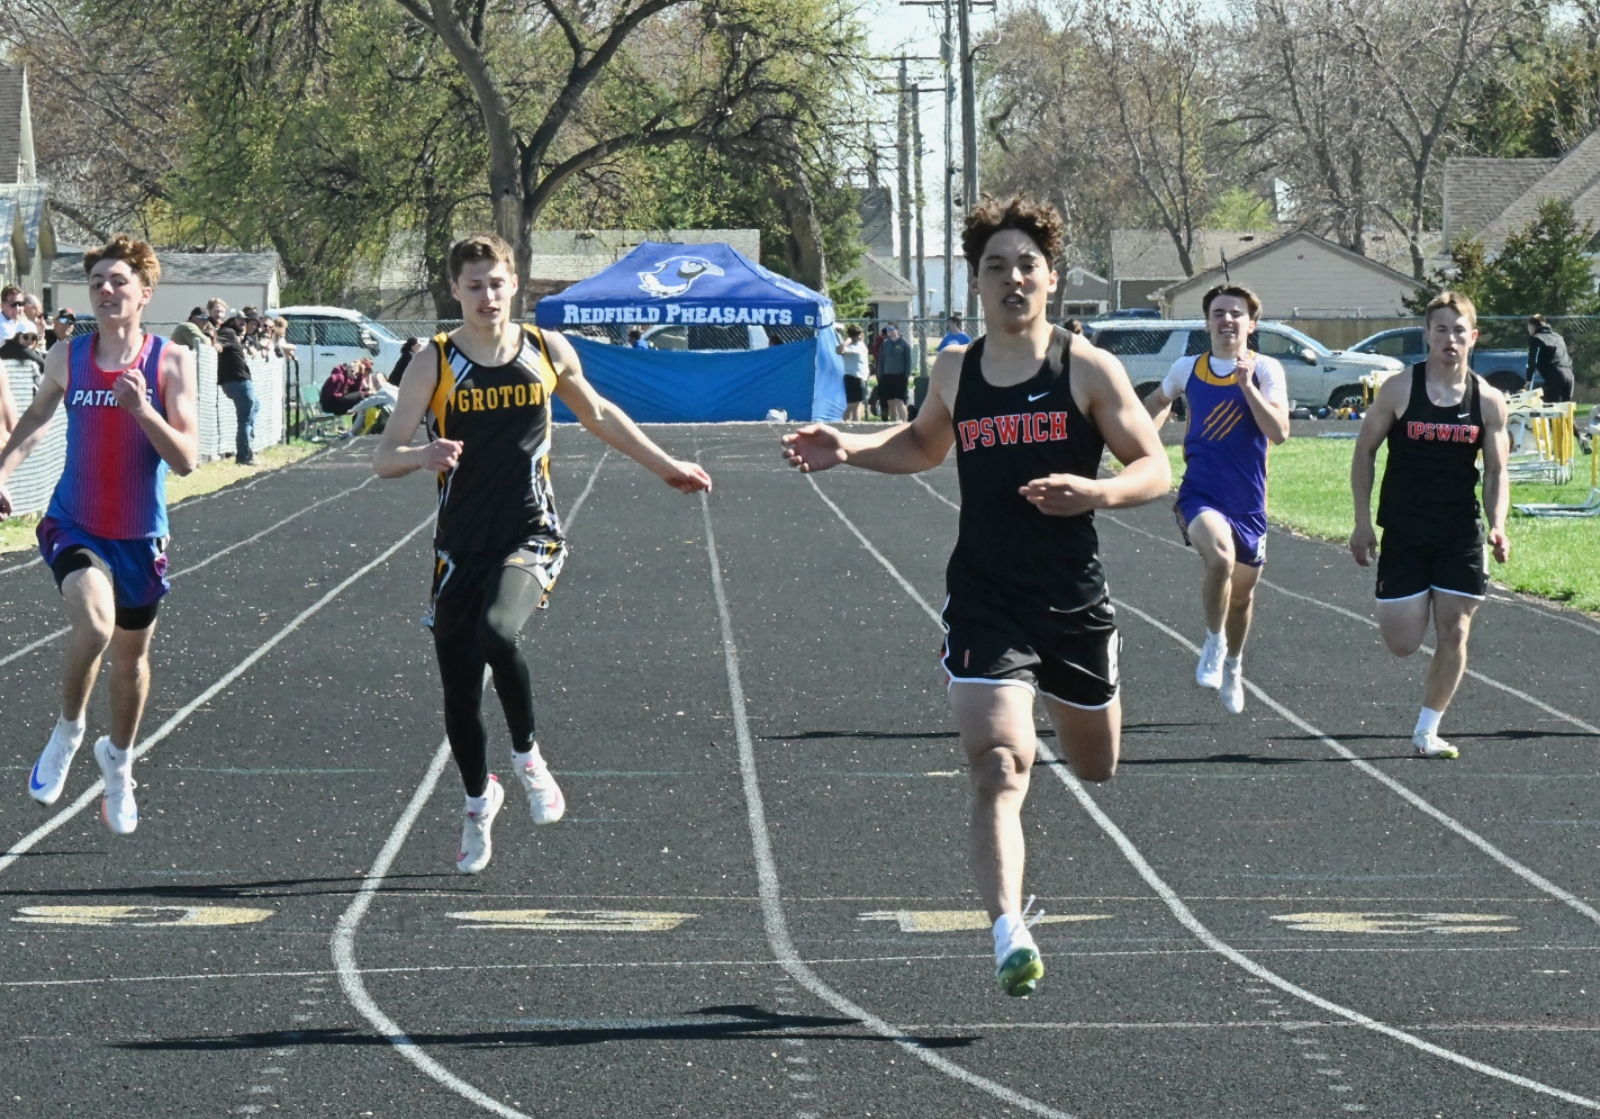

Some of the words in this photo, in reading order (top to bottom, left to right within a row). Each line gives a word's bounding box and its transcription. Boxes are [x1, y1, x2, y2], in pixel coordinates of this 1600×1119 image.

[563, 304, 660, 324] REDFIELD
[665, 304, 793, 326] PHEASANTS
[72, 388, 154, 407] PATRS
[458, 382, 543, 412] GROTON
[958, 411, 1068, 452] IPSWICH
[1407, 421, 1480, 444] IPSWICH
